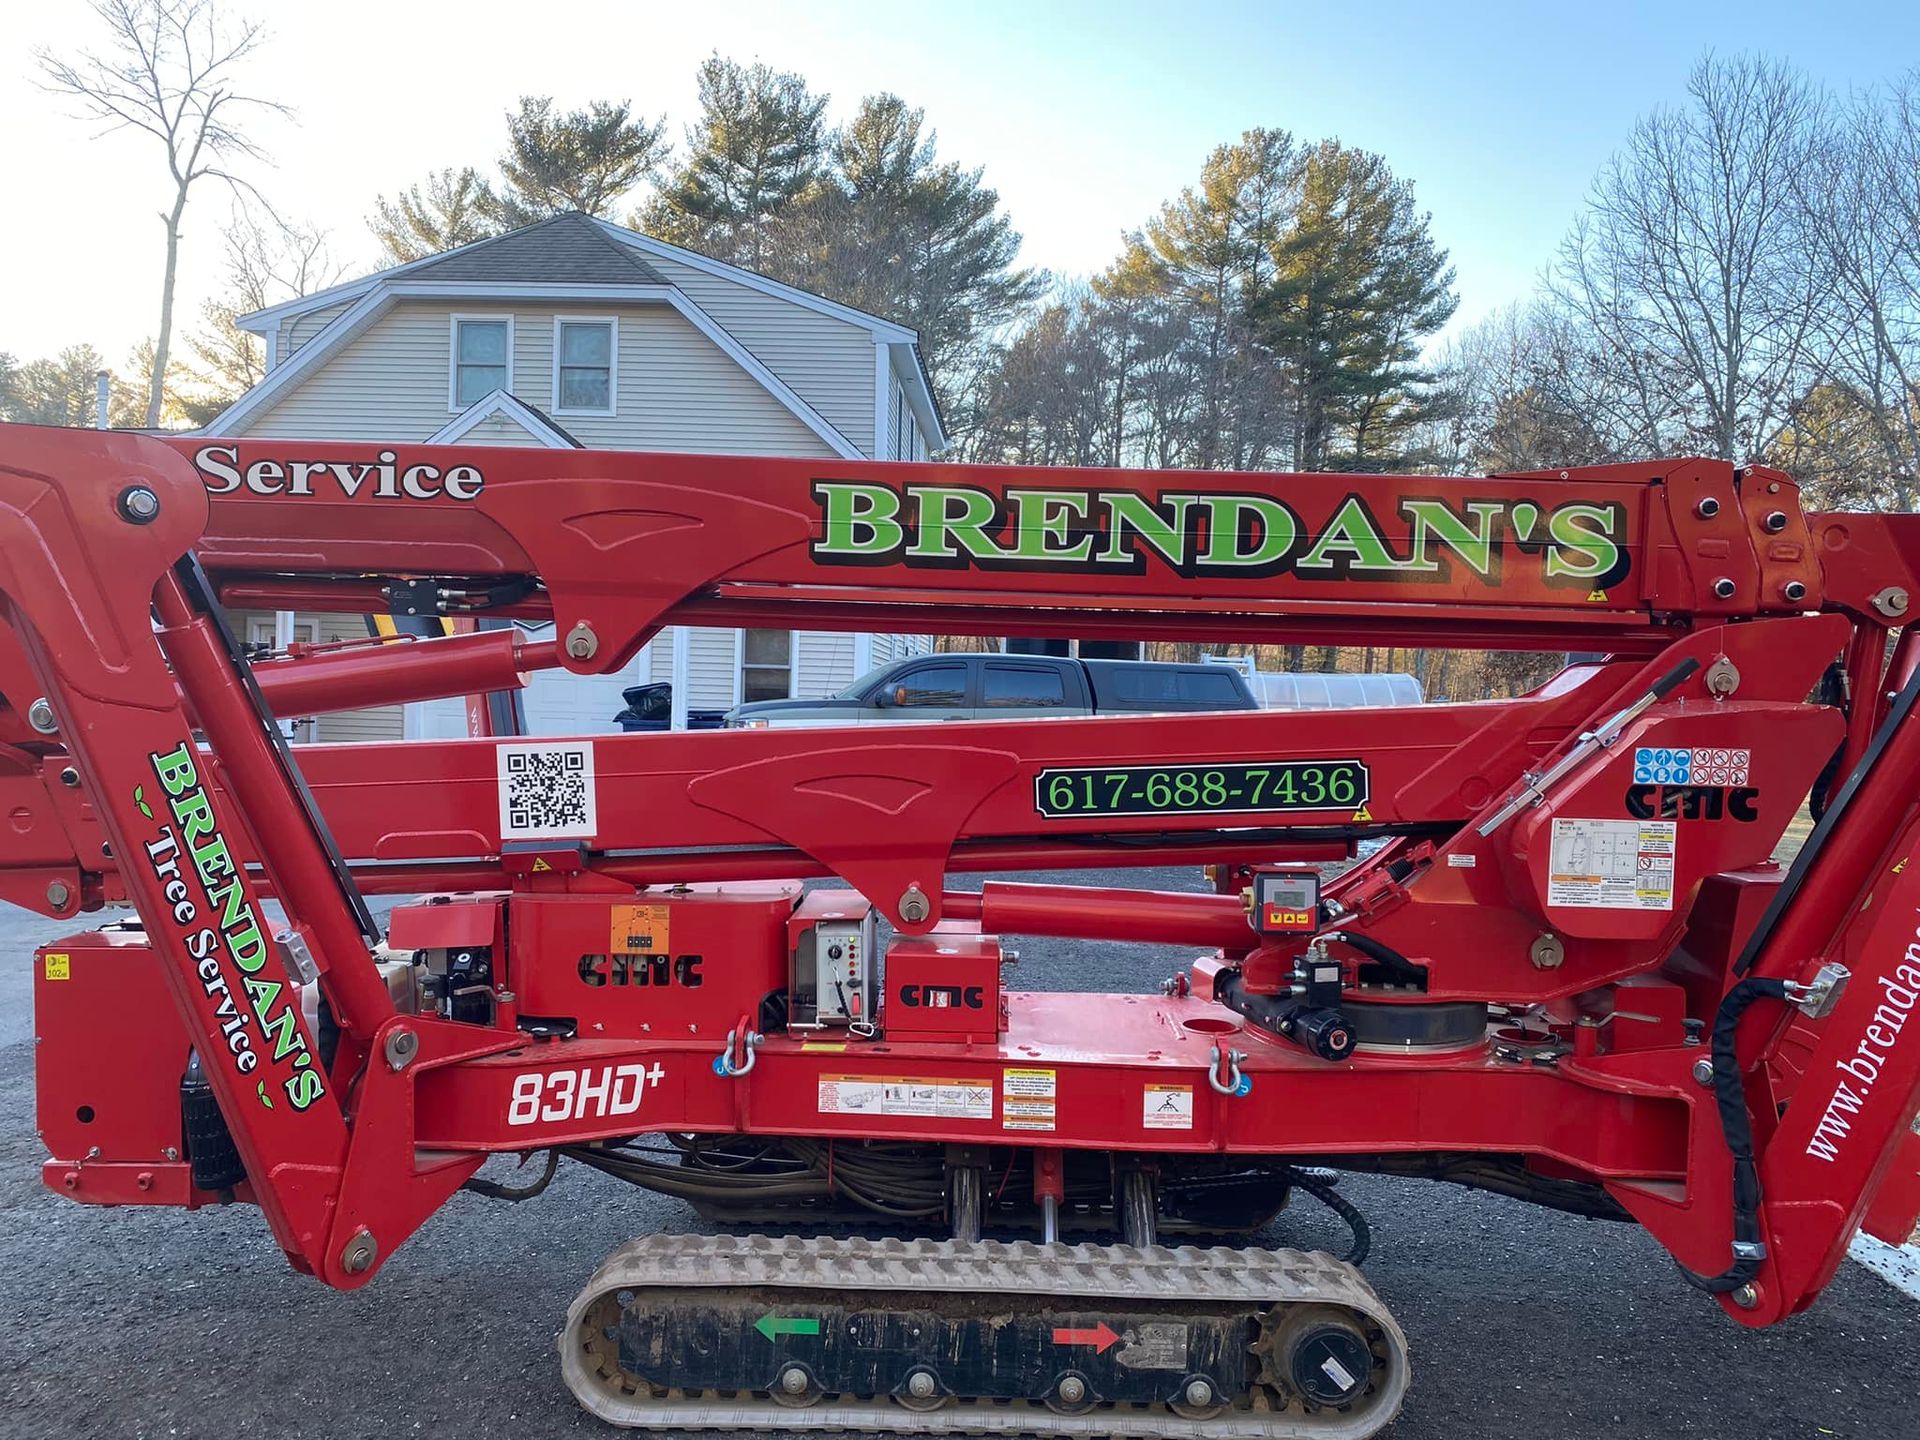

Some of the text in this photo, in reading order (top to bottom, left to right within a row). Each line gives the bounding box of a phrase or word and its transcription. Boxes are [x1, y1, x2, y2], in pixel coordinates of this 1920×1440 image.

[195, 446, 484, 499] Service
[812, 481, 1627, 582] BRENDAN'S
[1049, 767, 1356, 810] 617-688-7436
[145, 826, 258, 1073] Tree Service
[150, 743, 325, 1111] BRENDAN'S
